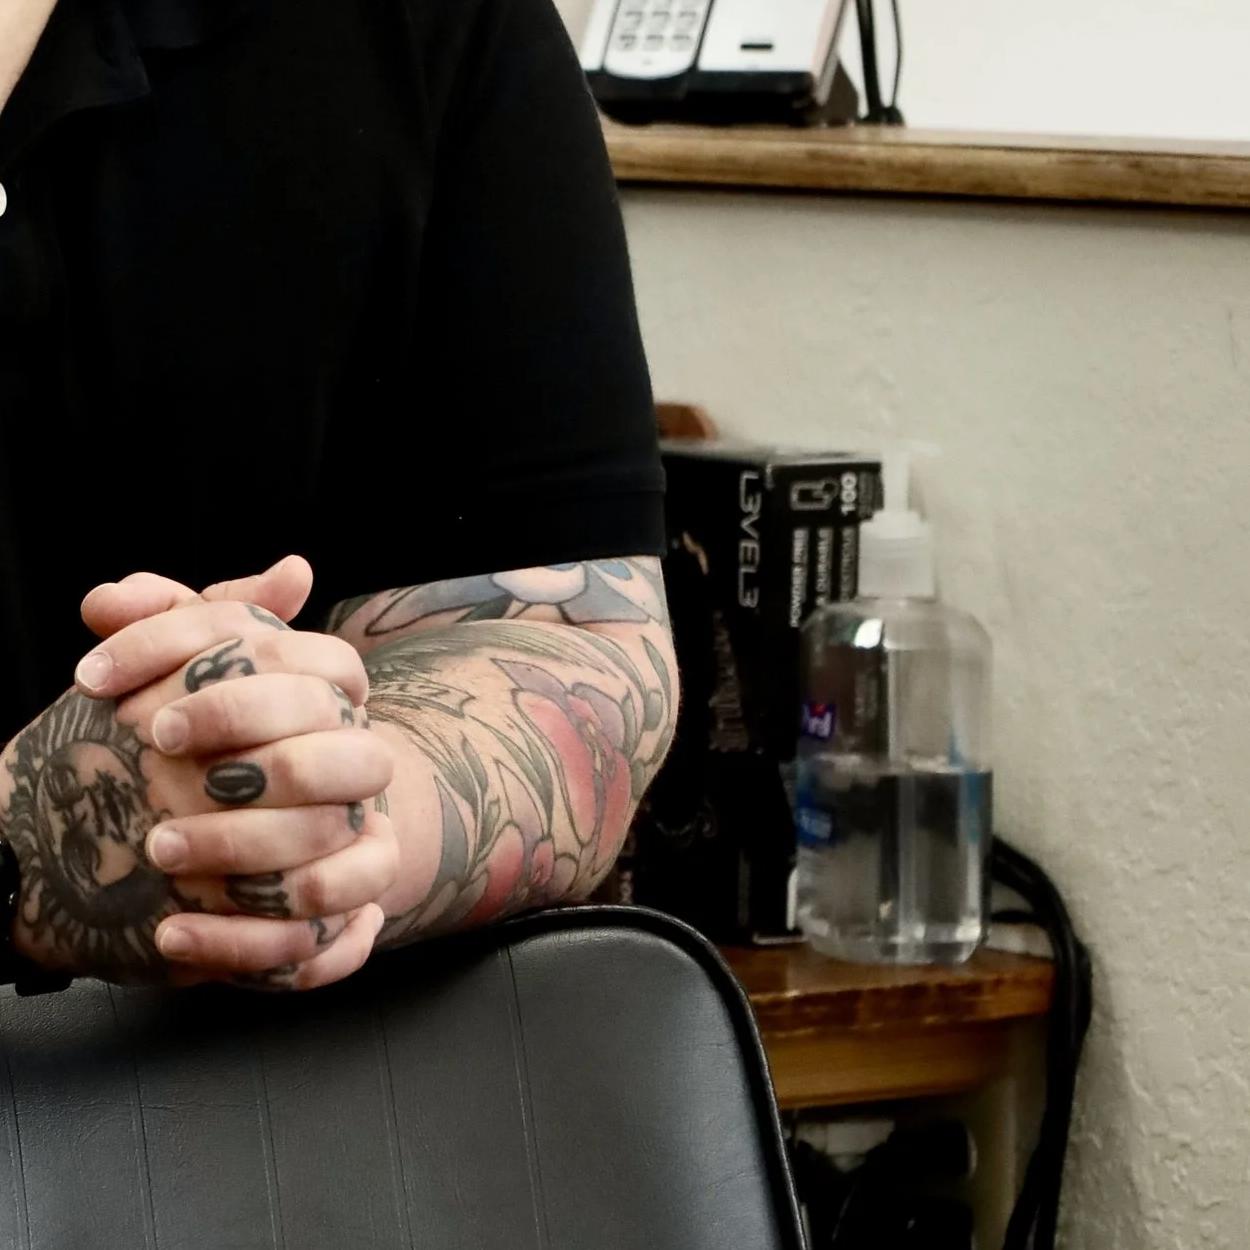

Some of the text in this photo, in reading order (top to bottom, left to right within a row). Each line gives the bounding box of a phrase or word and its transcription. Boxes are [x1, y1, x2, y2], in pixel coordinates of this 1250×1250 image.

[841, 472, 857, 516] 100
[738, 471, 762, 608] L3VEL3
[789, 566, 802, 628] POWDER
